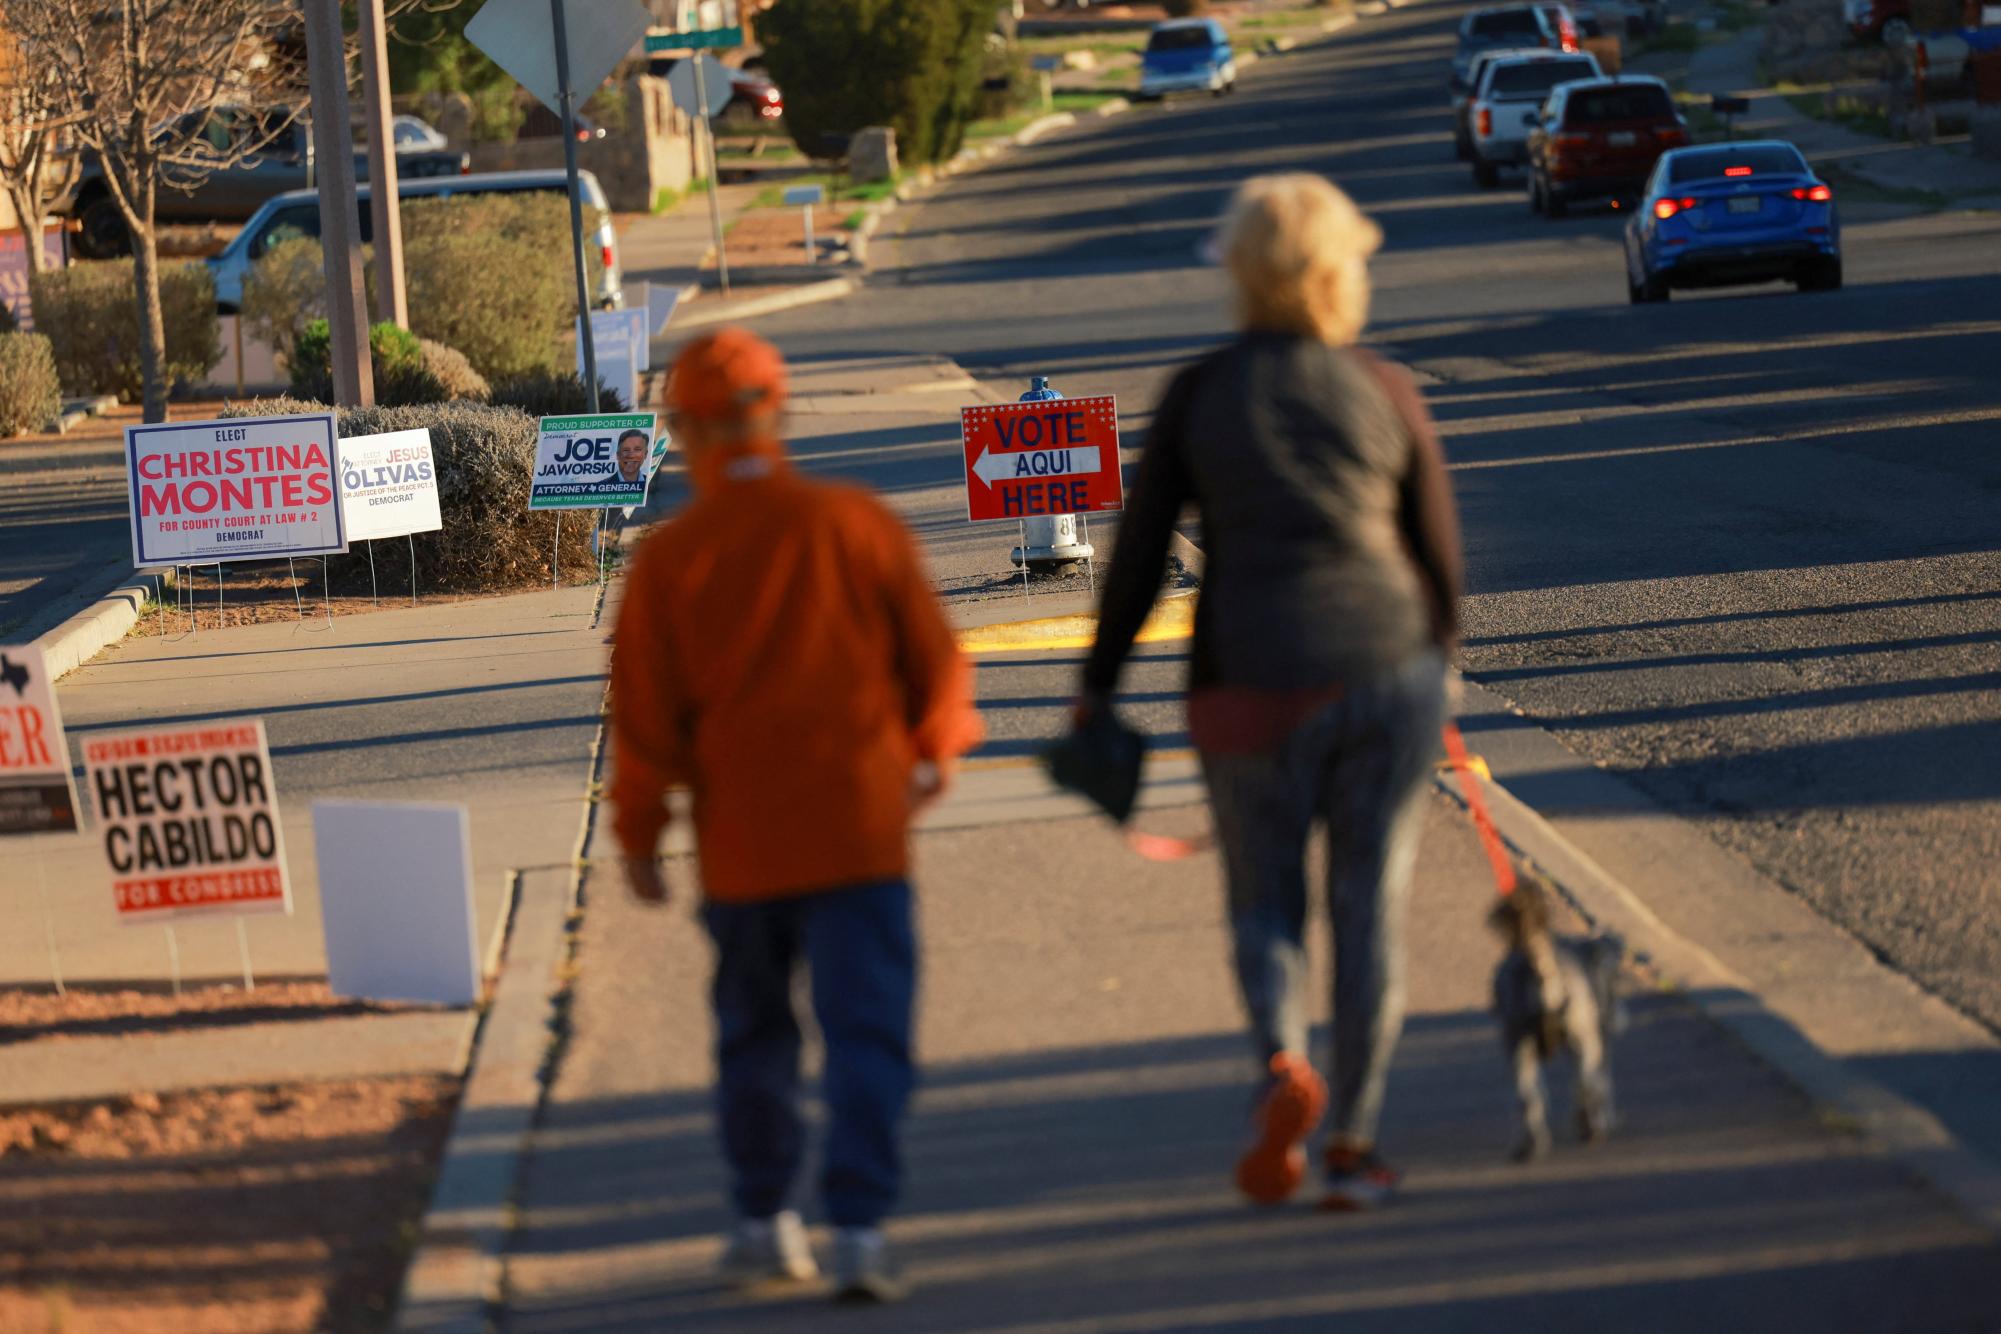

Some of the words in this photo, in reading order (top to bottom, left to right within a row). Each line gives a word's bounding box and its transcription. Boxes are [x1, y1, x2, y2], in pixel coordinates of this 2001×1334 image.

[215, 429, 246, 442] ELECT
[546, 422, 577, 430] PROUD
[580, 420, 633, 429] SUPPORTER
[635, 419, 649, 427] OF
[994, 412, 1087, 448] VOTE
[386, 446, 429, 463] JESUS
[554, 438, 612, 462] JOE
[138, 444, 328, 480] CHRISTINA
[538, 462, 616, 476] JAWORSKI
[1015, 450, 1071, 476] AQUI
[344, 461, 432, 489] OLIVAS
[141, 472, 331, 517] MONTES
[353, 489, 377, 498] JUSTICE
[387, 486, 397, 494] THE
[369, 493, 414, 506] DEMOCRAT
[536, 486, 587, 495] ATTORNEY
[598, 483, 642, 492] GENERAL
[1002, 480, 1089, 516] HERE
[159, 521, 178, 532] FOR
[182, 519, 220, 530] COUNTY
[224, 516, 256, 528] COURT
[260, 515, 271, 525] AT
[275, 513, 296, 524] LAW
[301, 513, 307, 522] #
[311, 511, 318, 522] 2
[216, 530, 264, 542] DEMOCRAT
[94, 752, 268, 820] HECTOR
[105, 811, 277, 875] CABILDO
